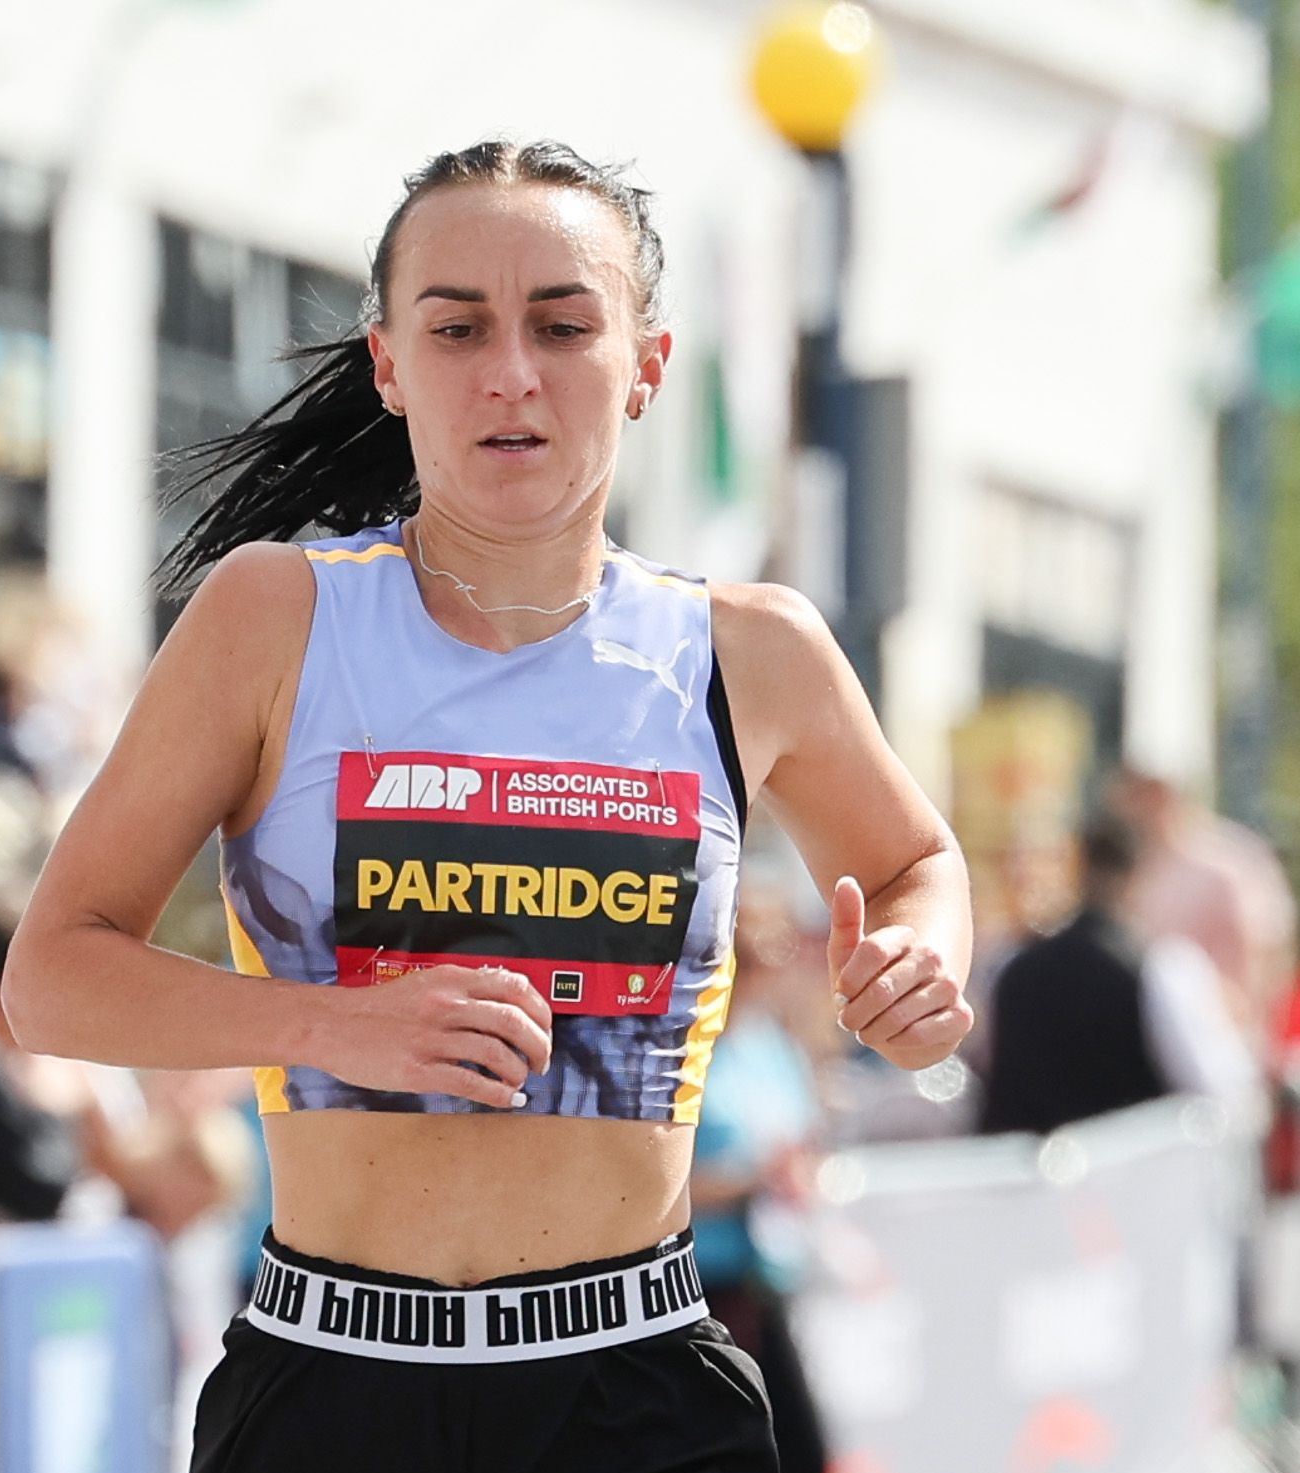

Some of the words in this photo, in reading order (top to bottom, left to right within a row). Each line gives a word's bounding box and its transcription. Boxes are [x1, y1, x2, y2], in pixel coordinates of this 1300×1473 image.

[364, 763, 483, 812] ABP
[506, 771, 649, 800] ASSOCIATED
[506, 795, 598, 819] BRITISH
[602, 800, 678, 826] PORTS
[356, 858, 679, 926] PARTRIDGE
[556, 982, 577, 992] ELITE
